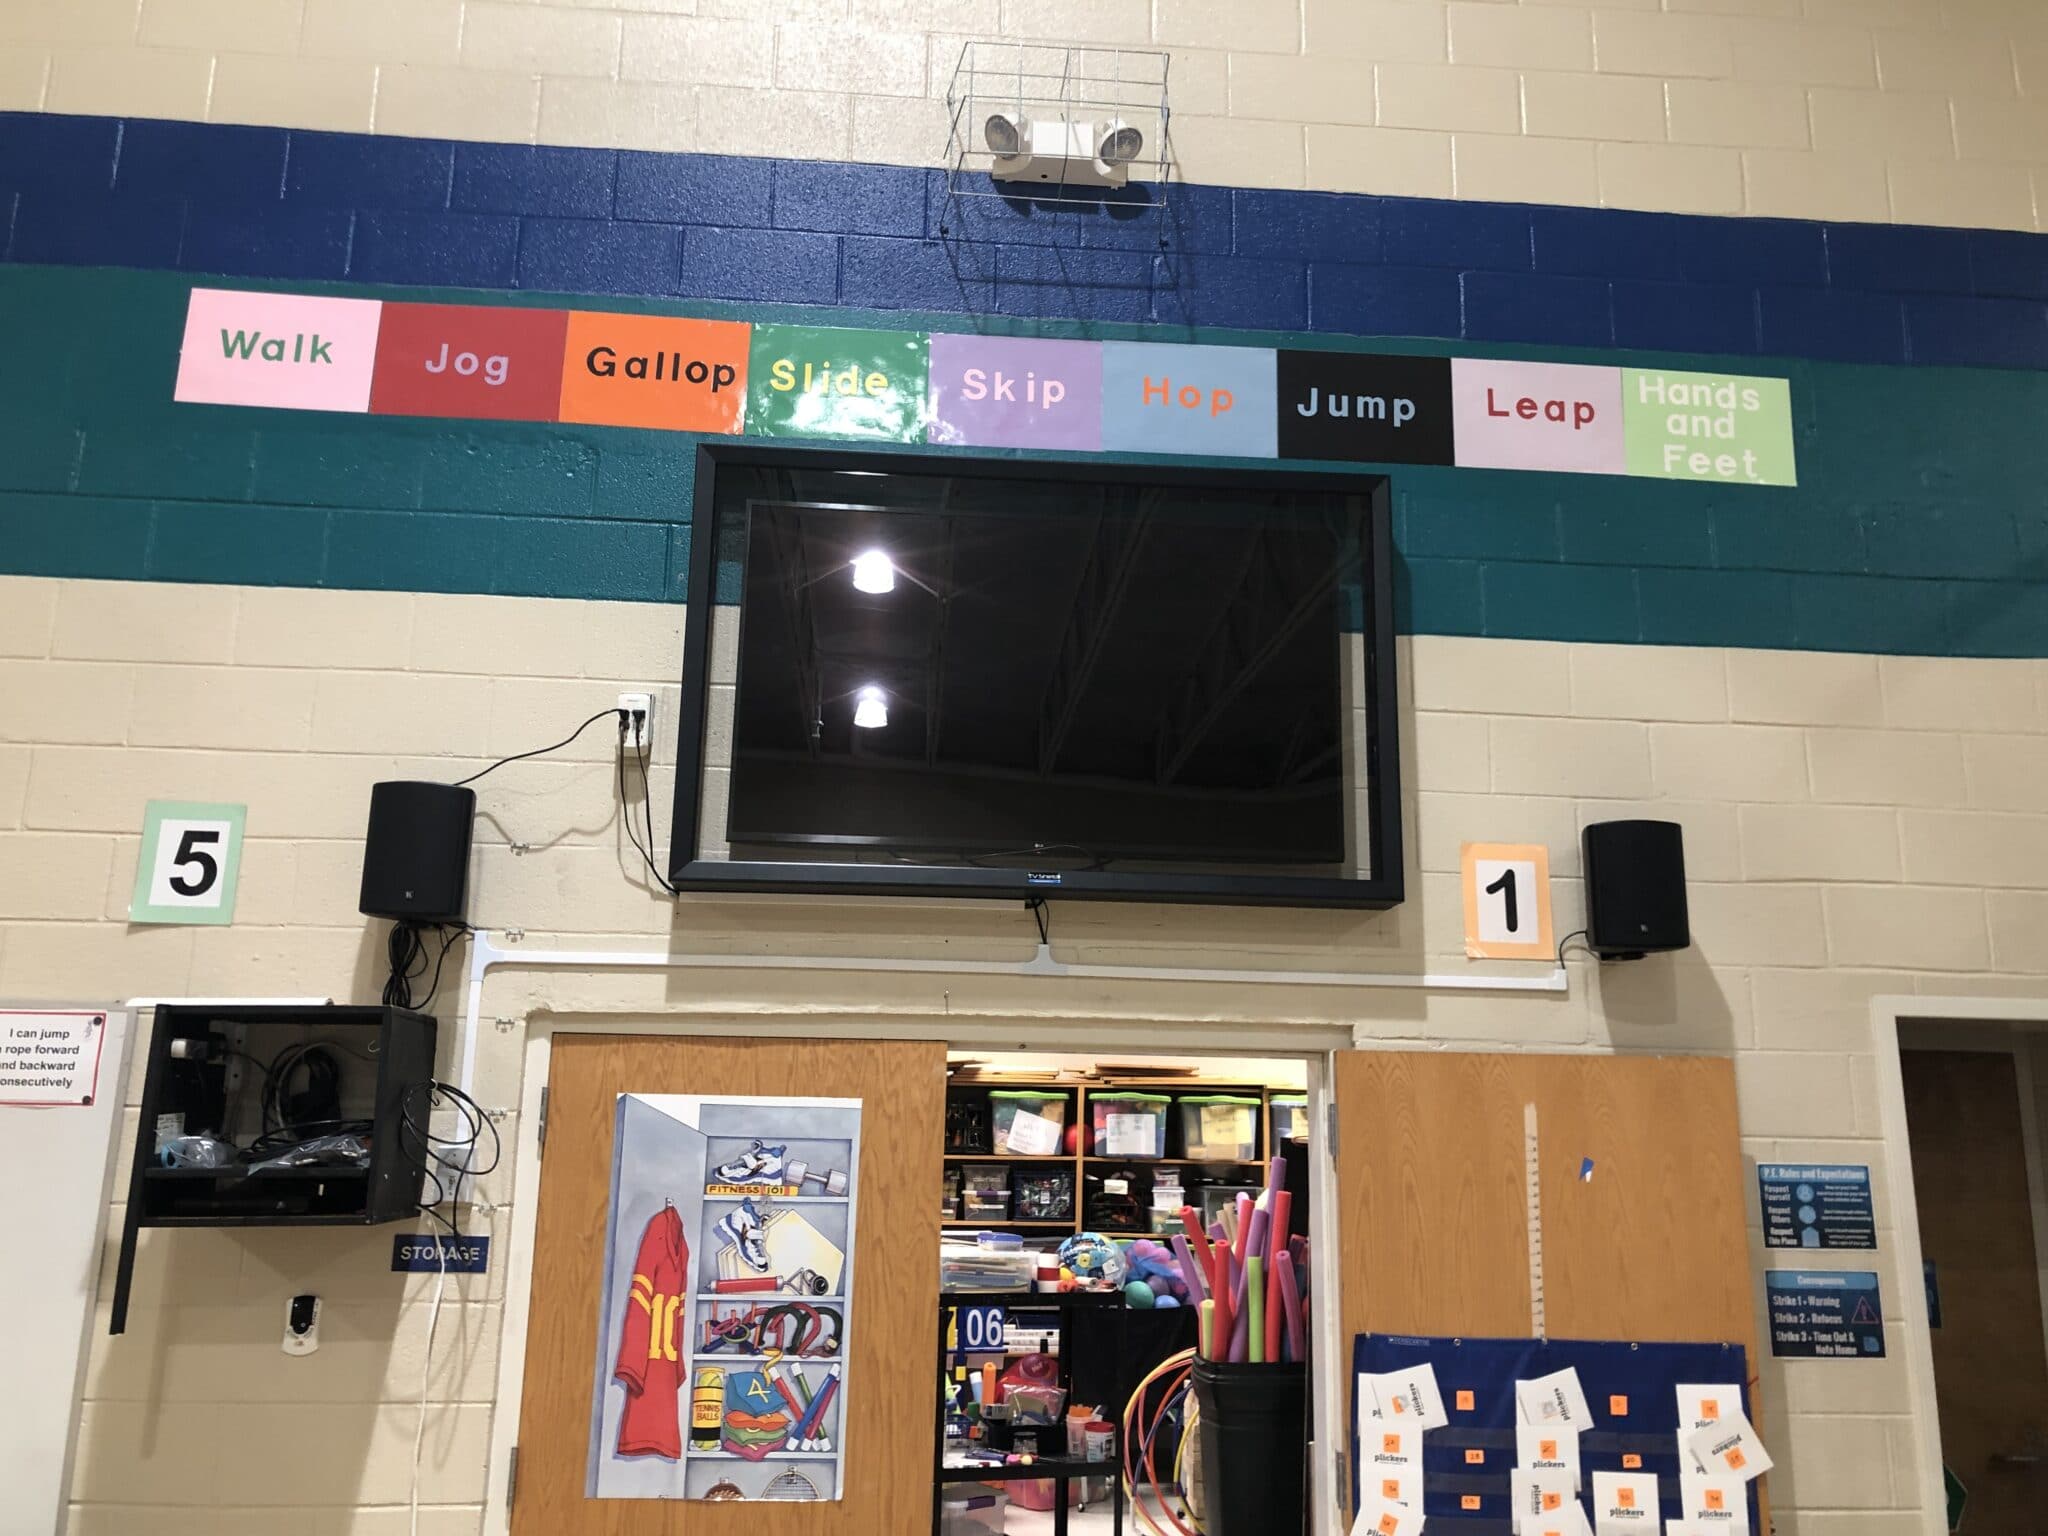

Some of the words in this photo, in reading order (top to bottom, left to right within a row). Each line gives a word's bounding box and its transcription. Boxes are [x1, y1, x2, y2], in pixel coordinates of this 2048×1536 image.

[220, 328, 334, 366] Walk
[424, 342, 510, 387] Jog
[586, 345, 738, 394] Gallop
[770, 358, 890, 398] Slide
[961, 368, 1067, 408] Skip
[1142, 375, 1236, 418] Hop
[1638, 375, 1761, 411] Hands
[1296, 387, 1418, 429] Jump
[1487, 388, 1597, 431] Leap
[1665, 409, 1738, 440] and
[1662, 445, 1760, 480] Feet
[168, 830, 220, 897] 5
[1485, 869, 1518, 933] 1
[9, 1028, 13, 1038] I
[16, 1030, 37, 1038] can
[39, 1029, 70, 1040] jump
[0, 1061, 16, 1070] nd
[19, 1061, 75, 1071] backward
[5, 1046, 31, 1056] rope
[35, 1045, 80, 1055] forward
[0, 1077, 73, 1089] onsecutively
[709, 1185, 759, 1194] FITNESS
[1772, 1295, 1797, 1306] Strike
[1807, 1295, 1841, 1308] Warning
[648, 1292, 679, 1361] 10
[966, 1308, 1003, 1346] 06
[1774, 1312, 1798, 1323] Strike
[1776, 1331, 1800, 1342] Strike
[695, 1404, 720, 1412] TENNIS
[697, 1412, 719, 1421] BALLS
[1374, 1454, 1408, 1463] plickers
[1533, 1461, 1565, 1469] plickers
[1532, 1484, 1541, 1515] plicker
[1610, 1508, 1645, 1517] plickers
[1698, 1510, 1732, 1519] plickers
